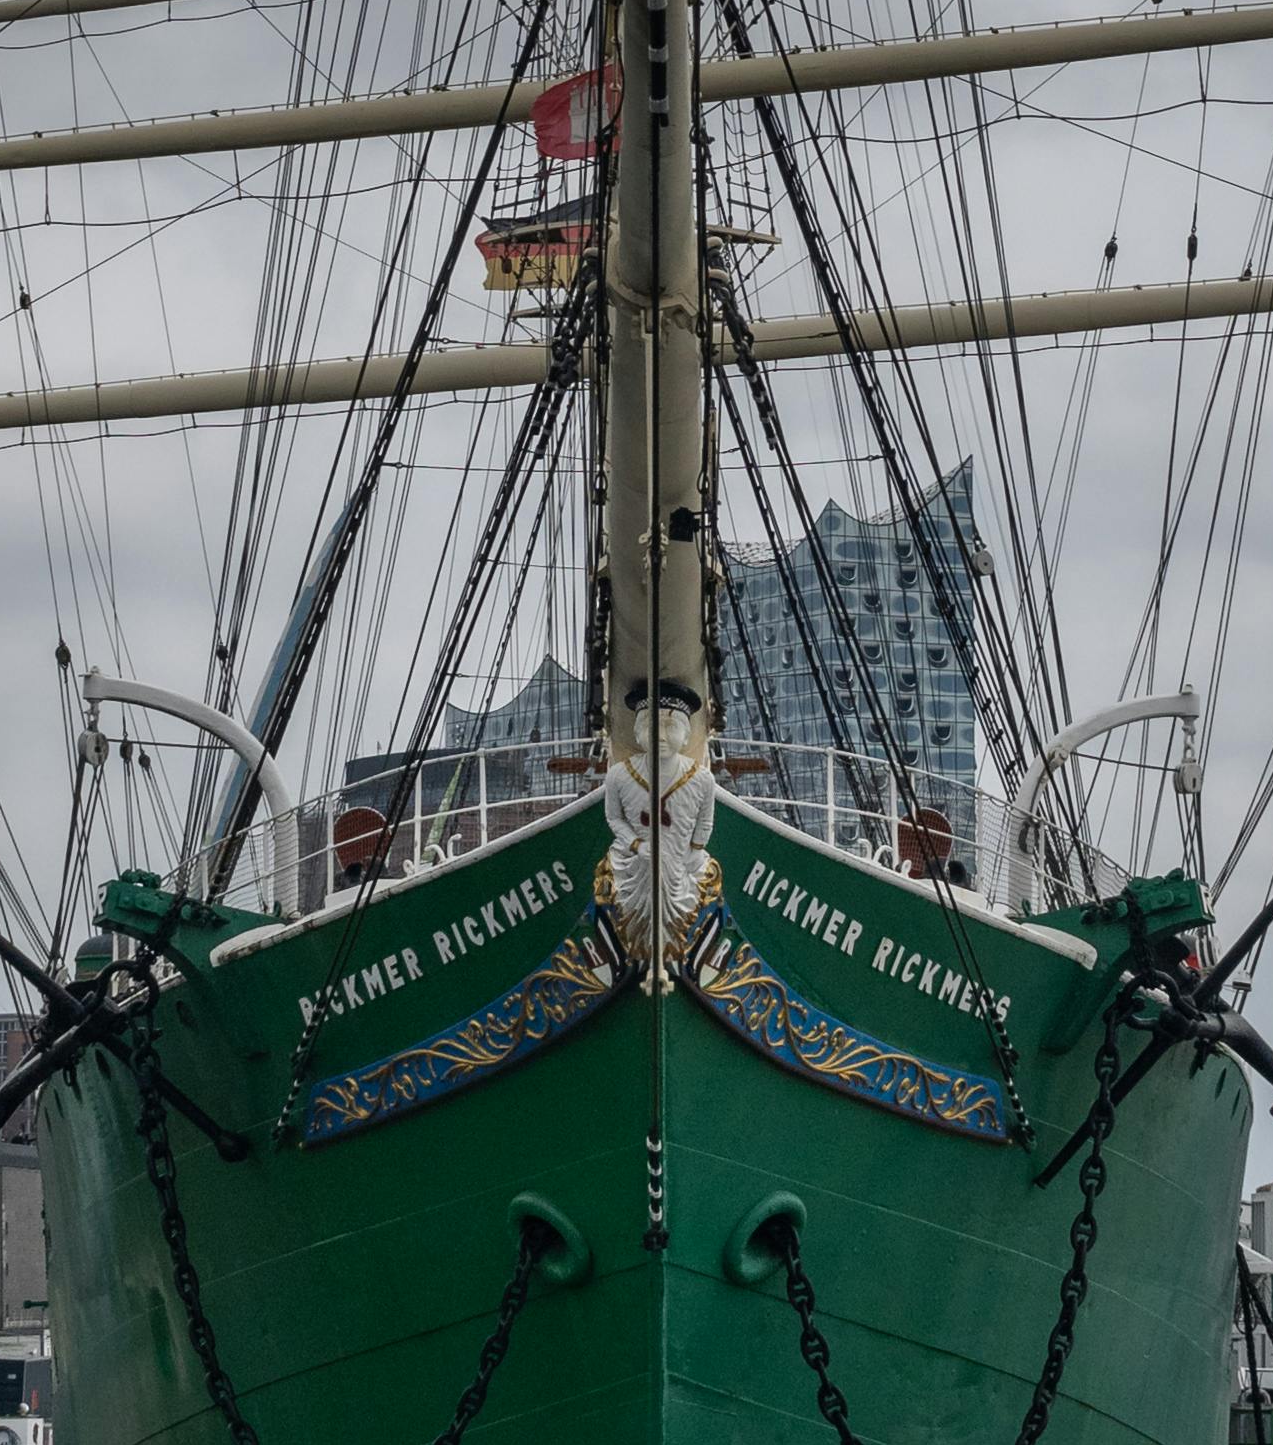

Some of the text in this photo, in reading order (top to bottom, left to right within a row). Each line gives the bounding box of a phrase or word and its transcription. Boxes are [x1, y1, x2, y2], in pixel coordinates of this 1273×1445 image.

[432, 860, 575, 966] RICKMERS
[742, 859, 1012, 1022] RICKMER RICKMERS
[583, 937, 604, 966] R
[713, 938, 733, 968] R
